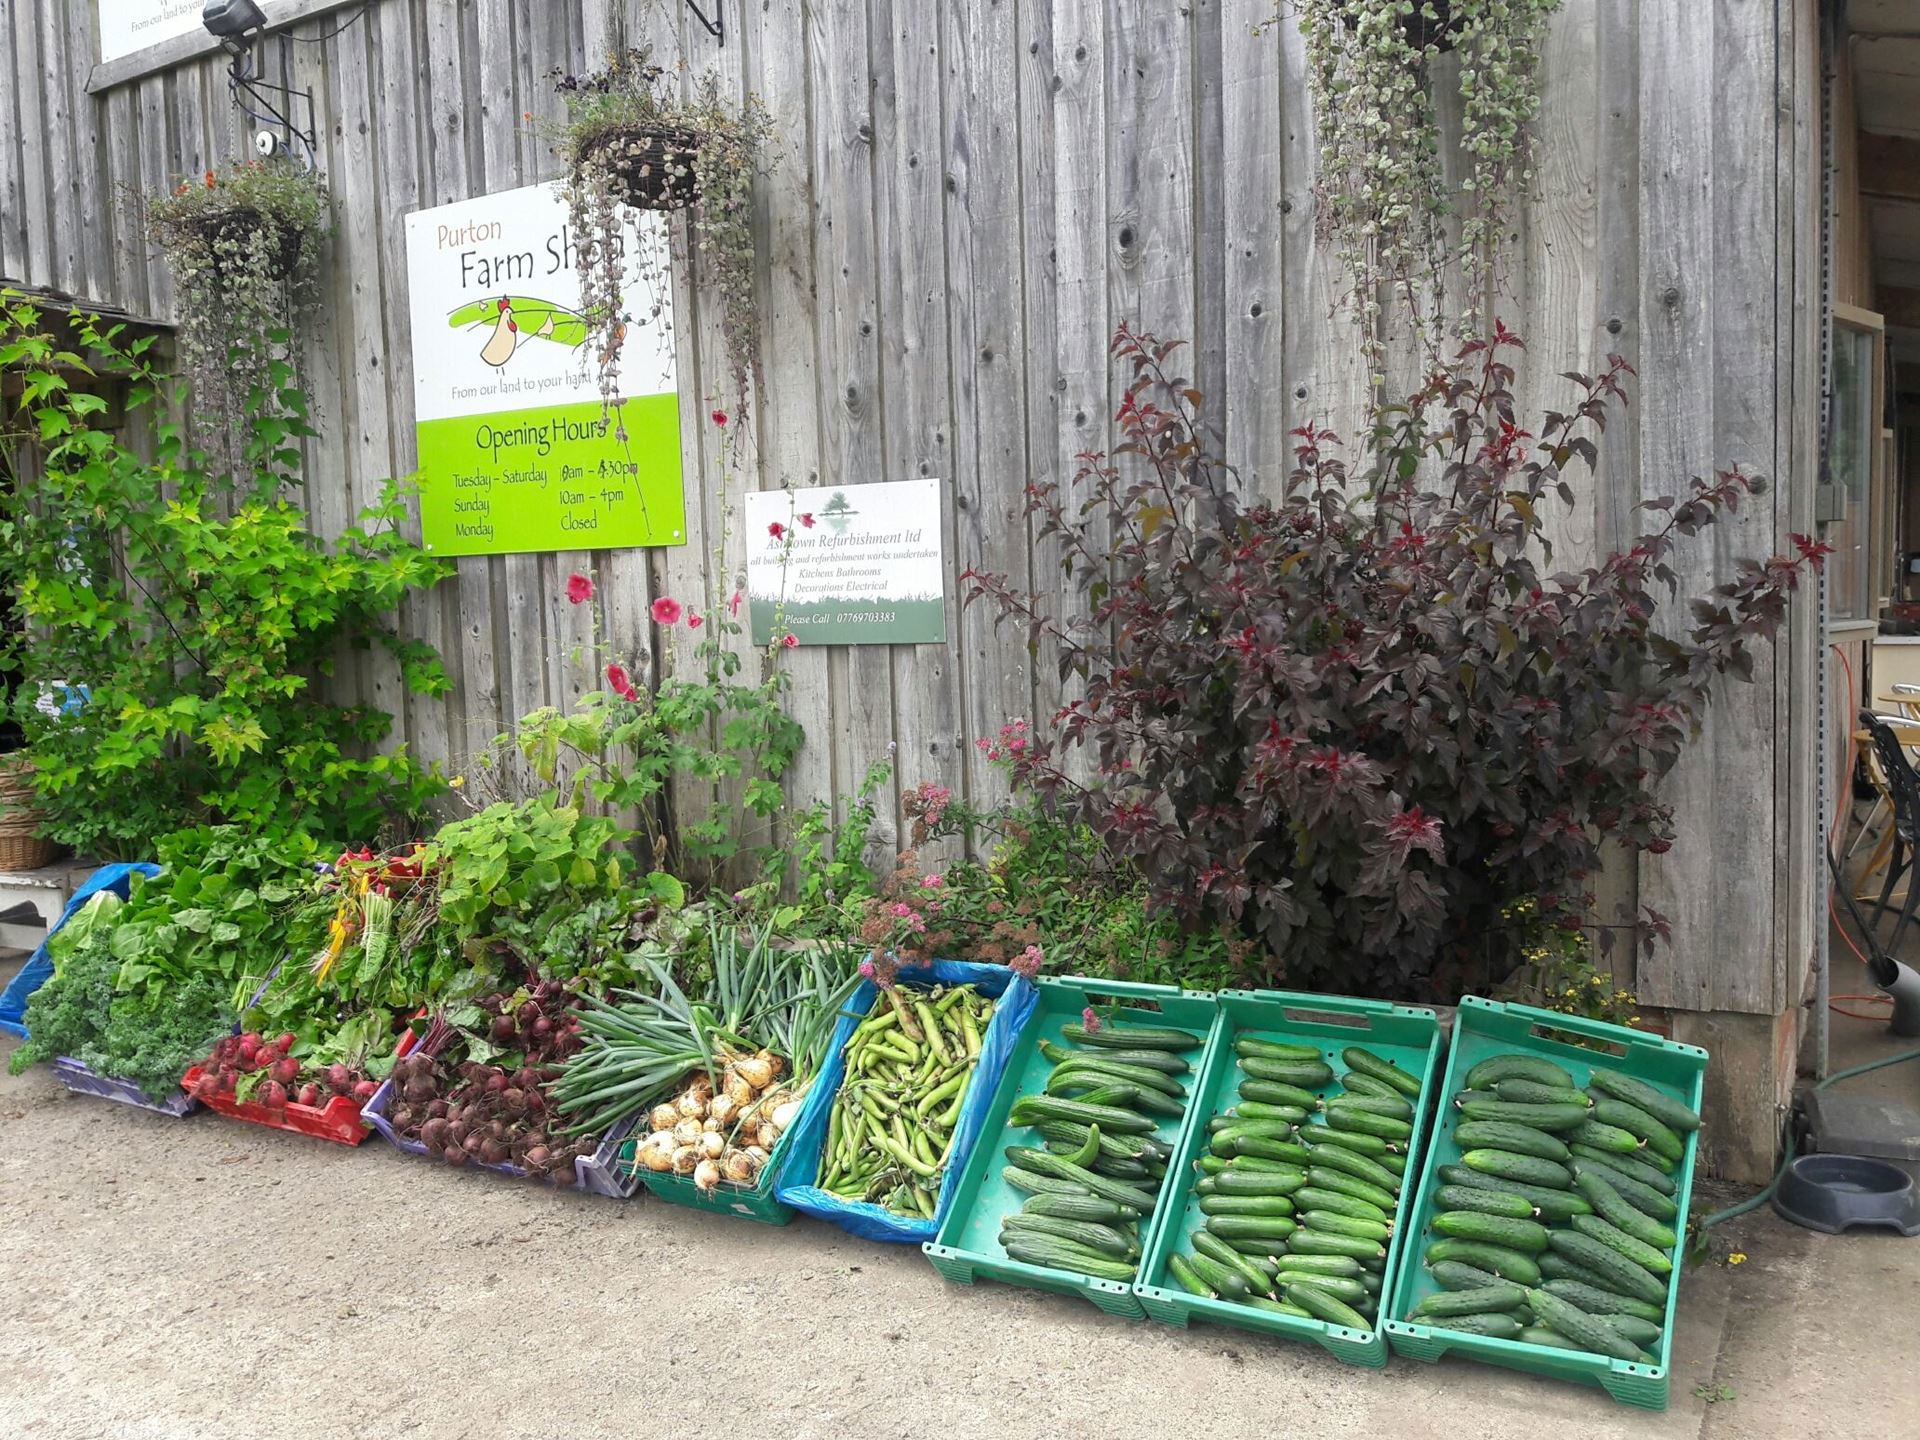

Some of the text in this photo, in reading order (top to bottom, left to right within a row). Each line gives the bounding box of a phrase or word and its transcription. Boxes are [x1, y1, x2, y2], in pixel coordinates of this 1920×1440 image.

[437, 219, 501, 250] Purton
[461, 250, 534, 288] Farm
[452, 385, 477, 399] From
[480, 384, 497, 396] our
[499, 377, 521, 394] land
[524, 378, 535, 390] to
[538, 375, 562, 392] your
[476, 417, 607, 464] Opening Hours
[453, 467, 491, 493] Tuesday
[502, 462, 547, 489] Saturday
[454, 492, 490, 518] Sunday
[559, 490, 585, 505] 10am
[600, 488, 624, 512] 4pm
[455, 508, 598, 543] Monday Closed
[819, 531, 902, 550] Refurbishment
[904, 528, 922, 543] ltd
[795, 554, 811, 565] and
[811, 552, 865, 565] refurbishment
[867, 550, 891, 561] works
[893, 548, 939, 560] undertaken
[798, 566, 882, 579] Kitchens Bathrooms
[845, 579, 888, 591] Electrical
[784, 611, 896, 624] Please Call 07769703383
